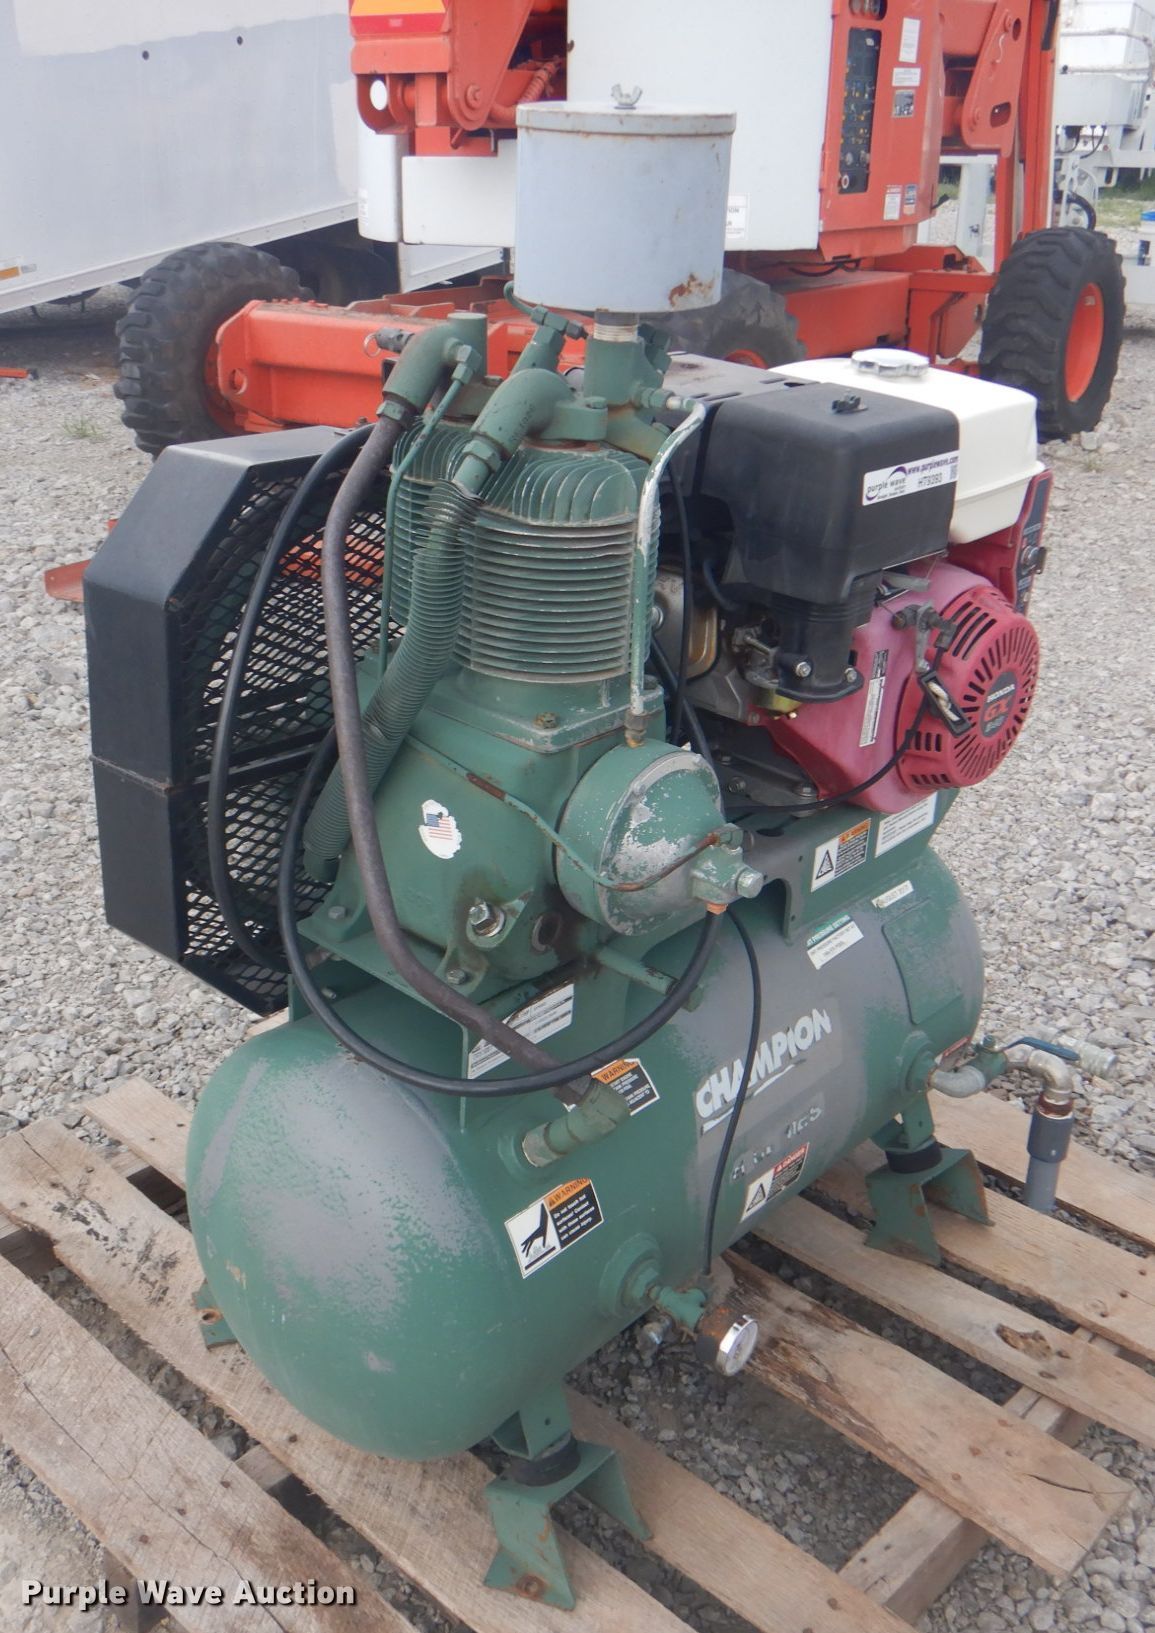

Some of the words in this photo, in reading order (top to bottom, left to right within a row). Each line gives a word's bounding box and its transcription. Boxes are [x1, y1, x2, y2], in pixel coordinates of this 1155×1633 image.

[867, 480, 888, 493] purple
[890, 478, 906, 487] wave
[695, 1008, 833, 1119] CHAMPION
